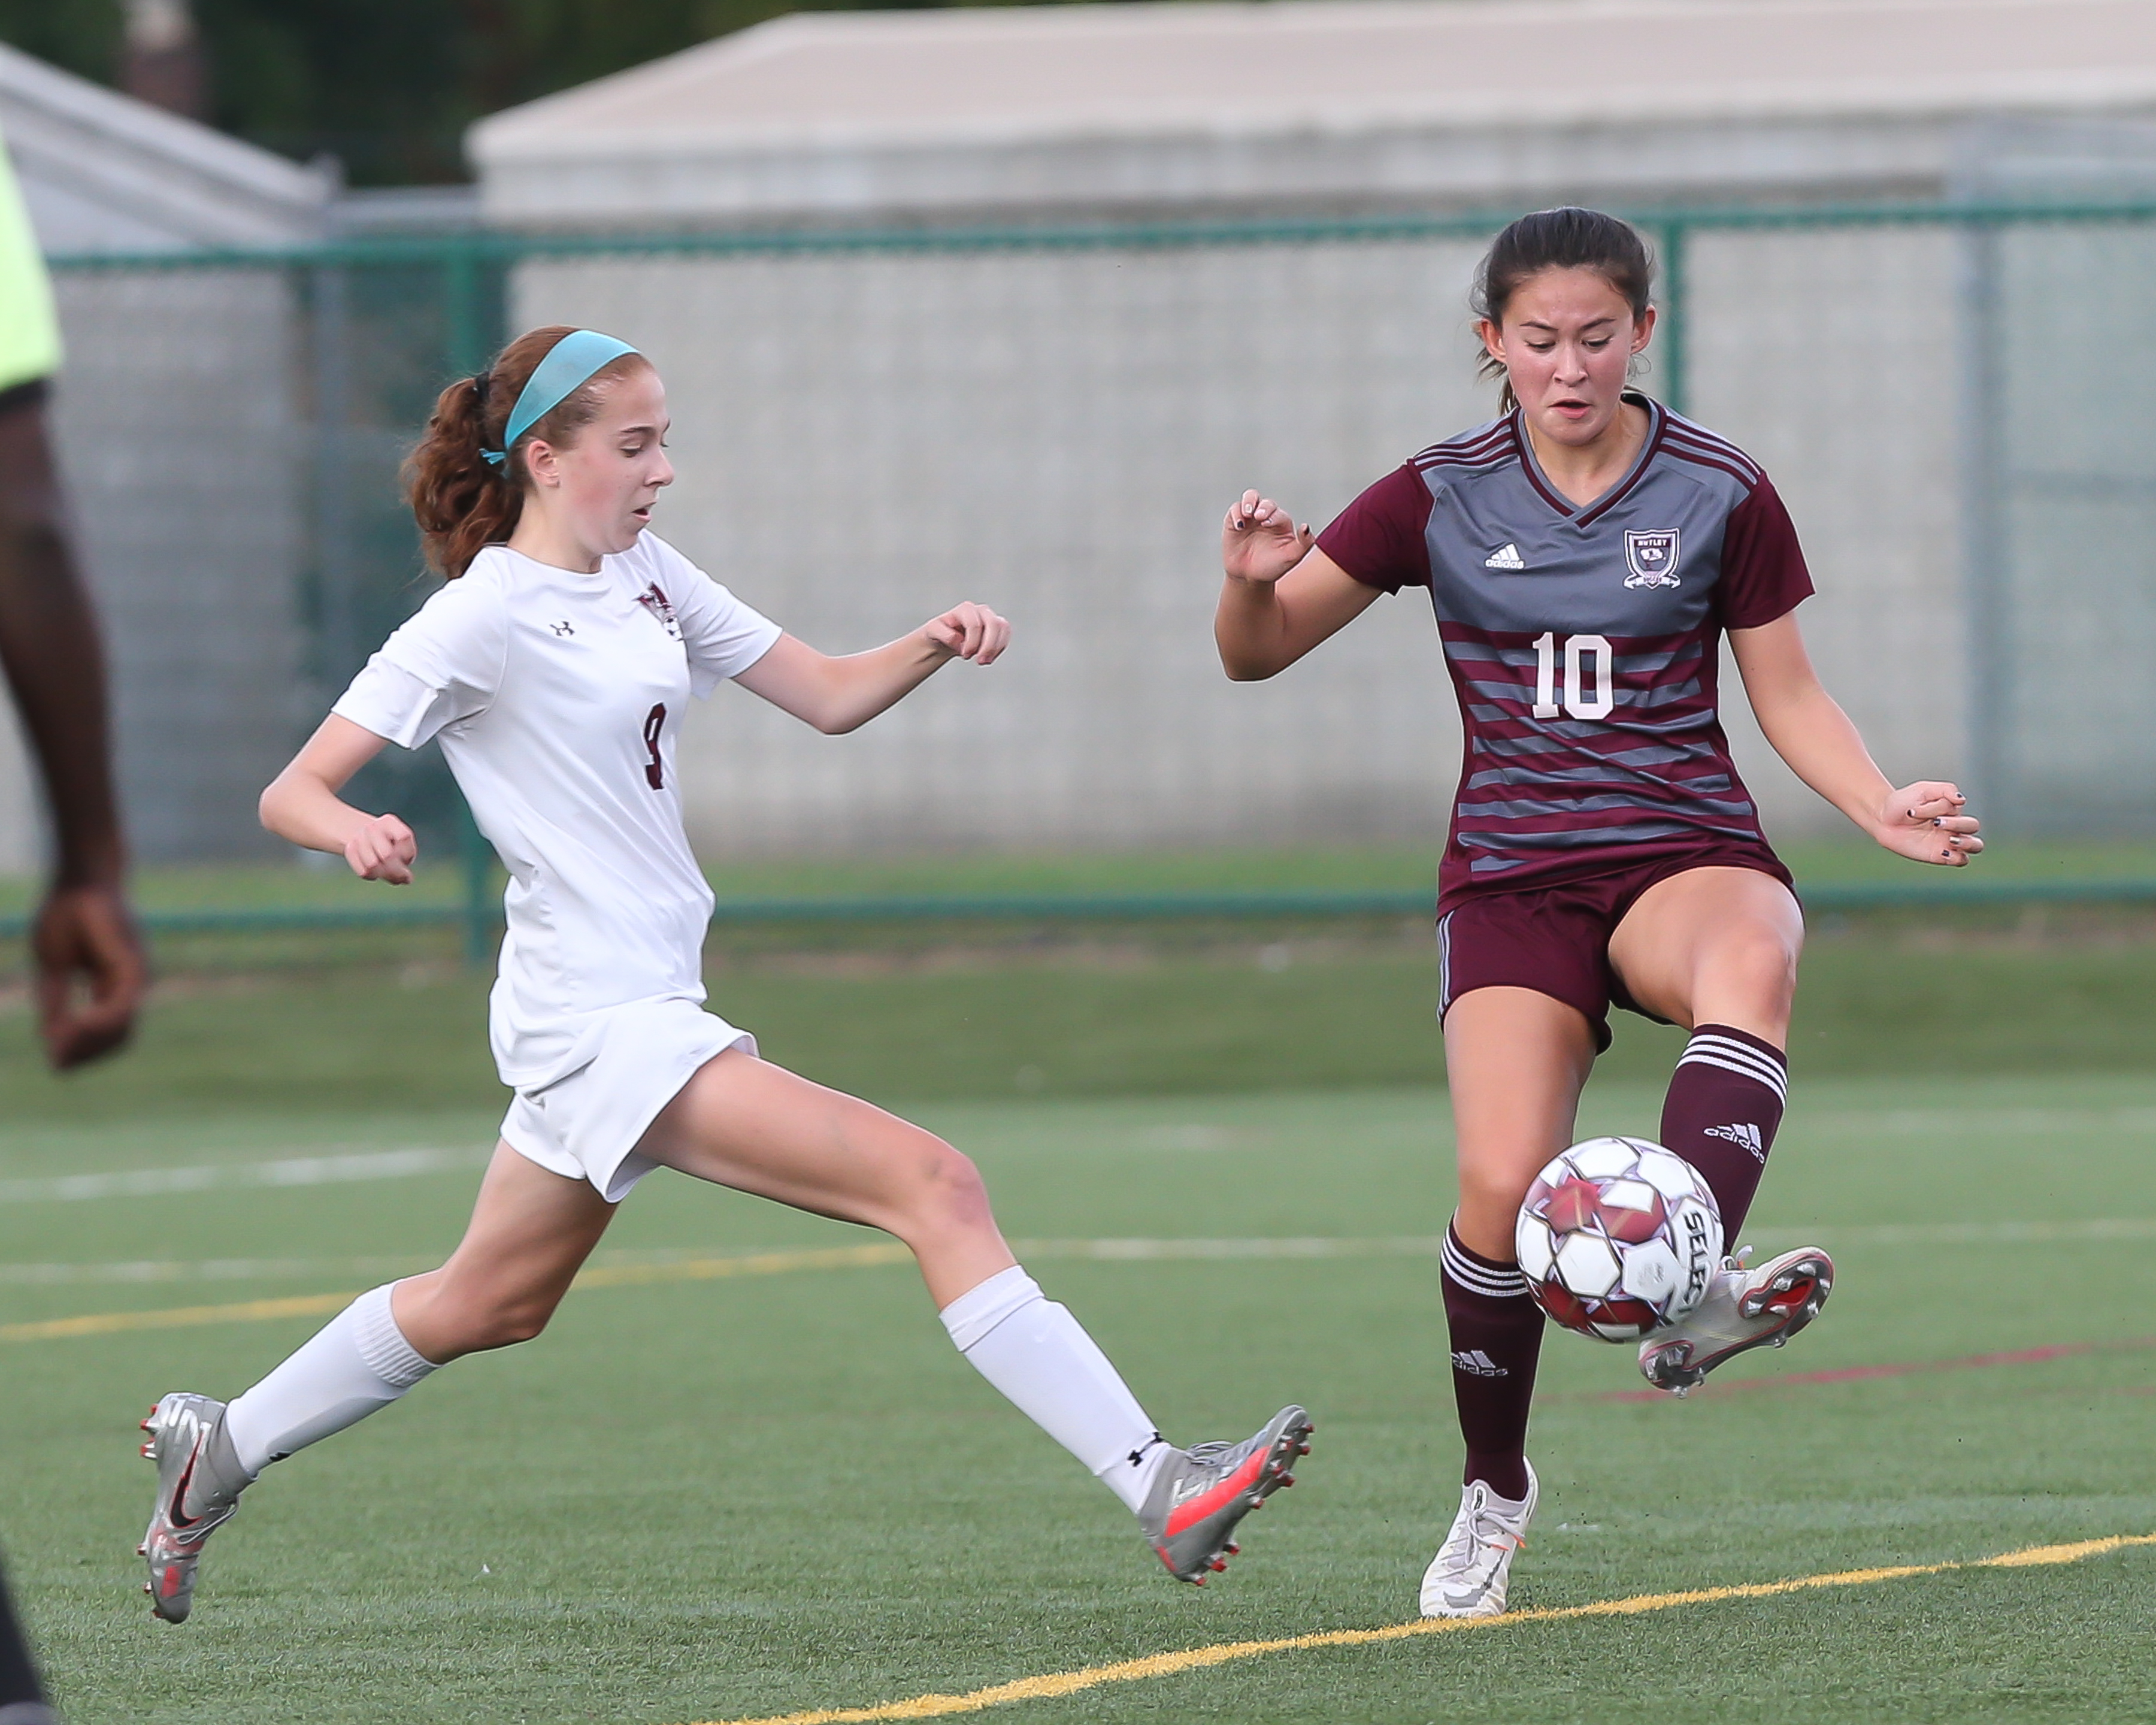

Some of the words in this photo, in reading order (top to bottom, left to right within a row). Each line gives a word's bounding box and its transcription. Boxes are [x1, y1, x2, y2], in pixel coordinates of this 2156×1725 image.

[1485, 558, 1524, 569] adidas
[1532, 632, 1614, 719] 10
[643, 701, 667, 791] 9
[1704, 1128, 1765, 1164] adidas
[1452, 1359, 1508, 1376] didas
